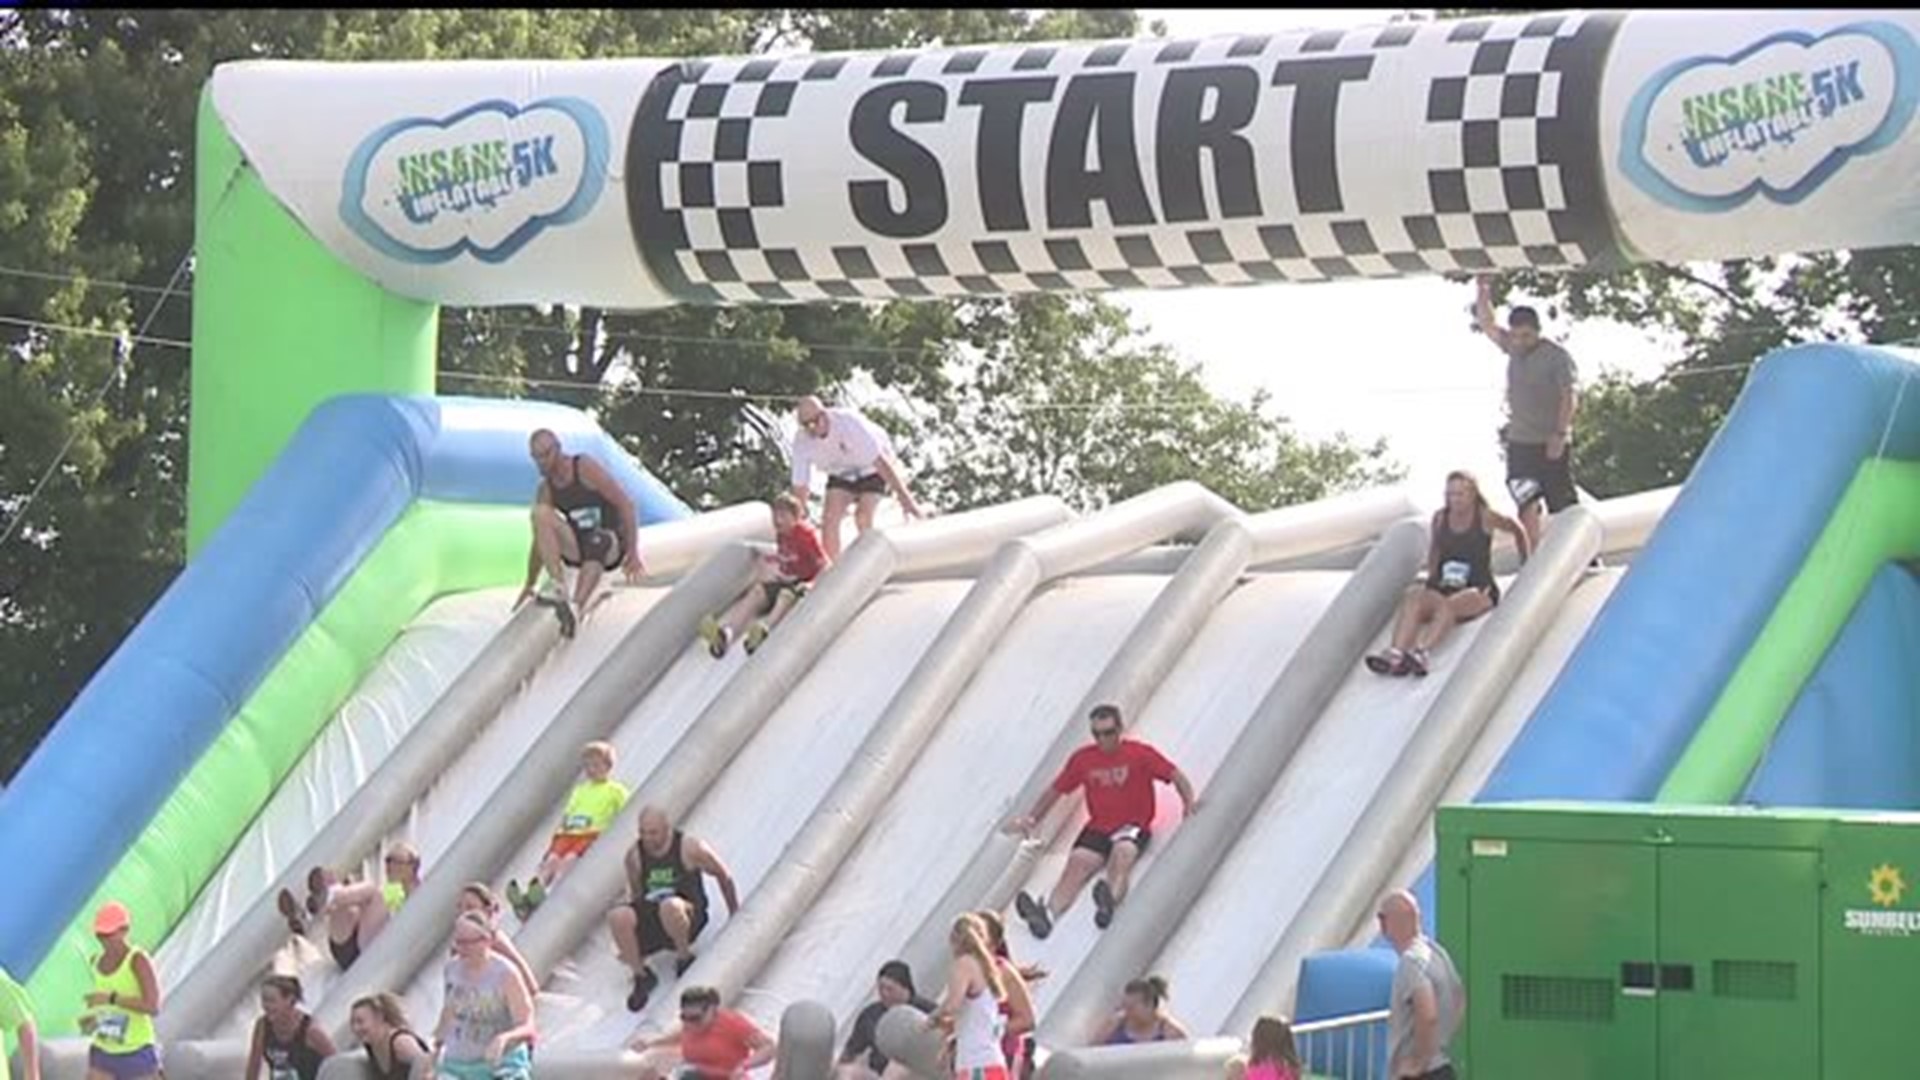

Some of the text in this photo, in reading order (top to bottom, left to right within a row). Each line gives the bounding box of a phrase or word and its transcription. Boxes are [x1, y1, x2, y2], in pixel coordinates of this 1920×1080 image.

[1682, 61, 1864, 140] INSANE 5K
[397, 135, 557, 195] INSANE 5K
[848, 54, 1375, 239] START
